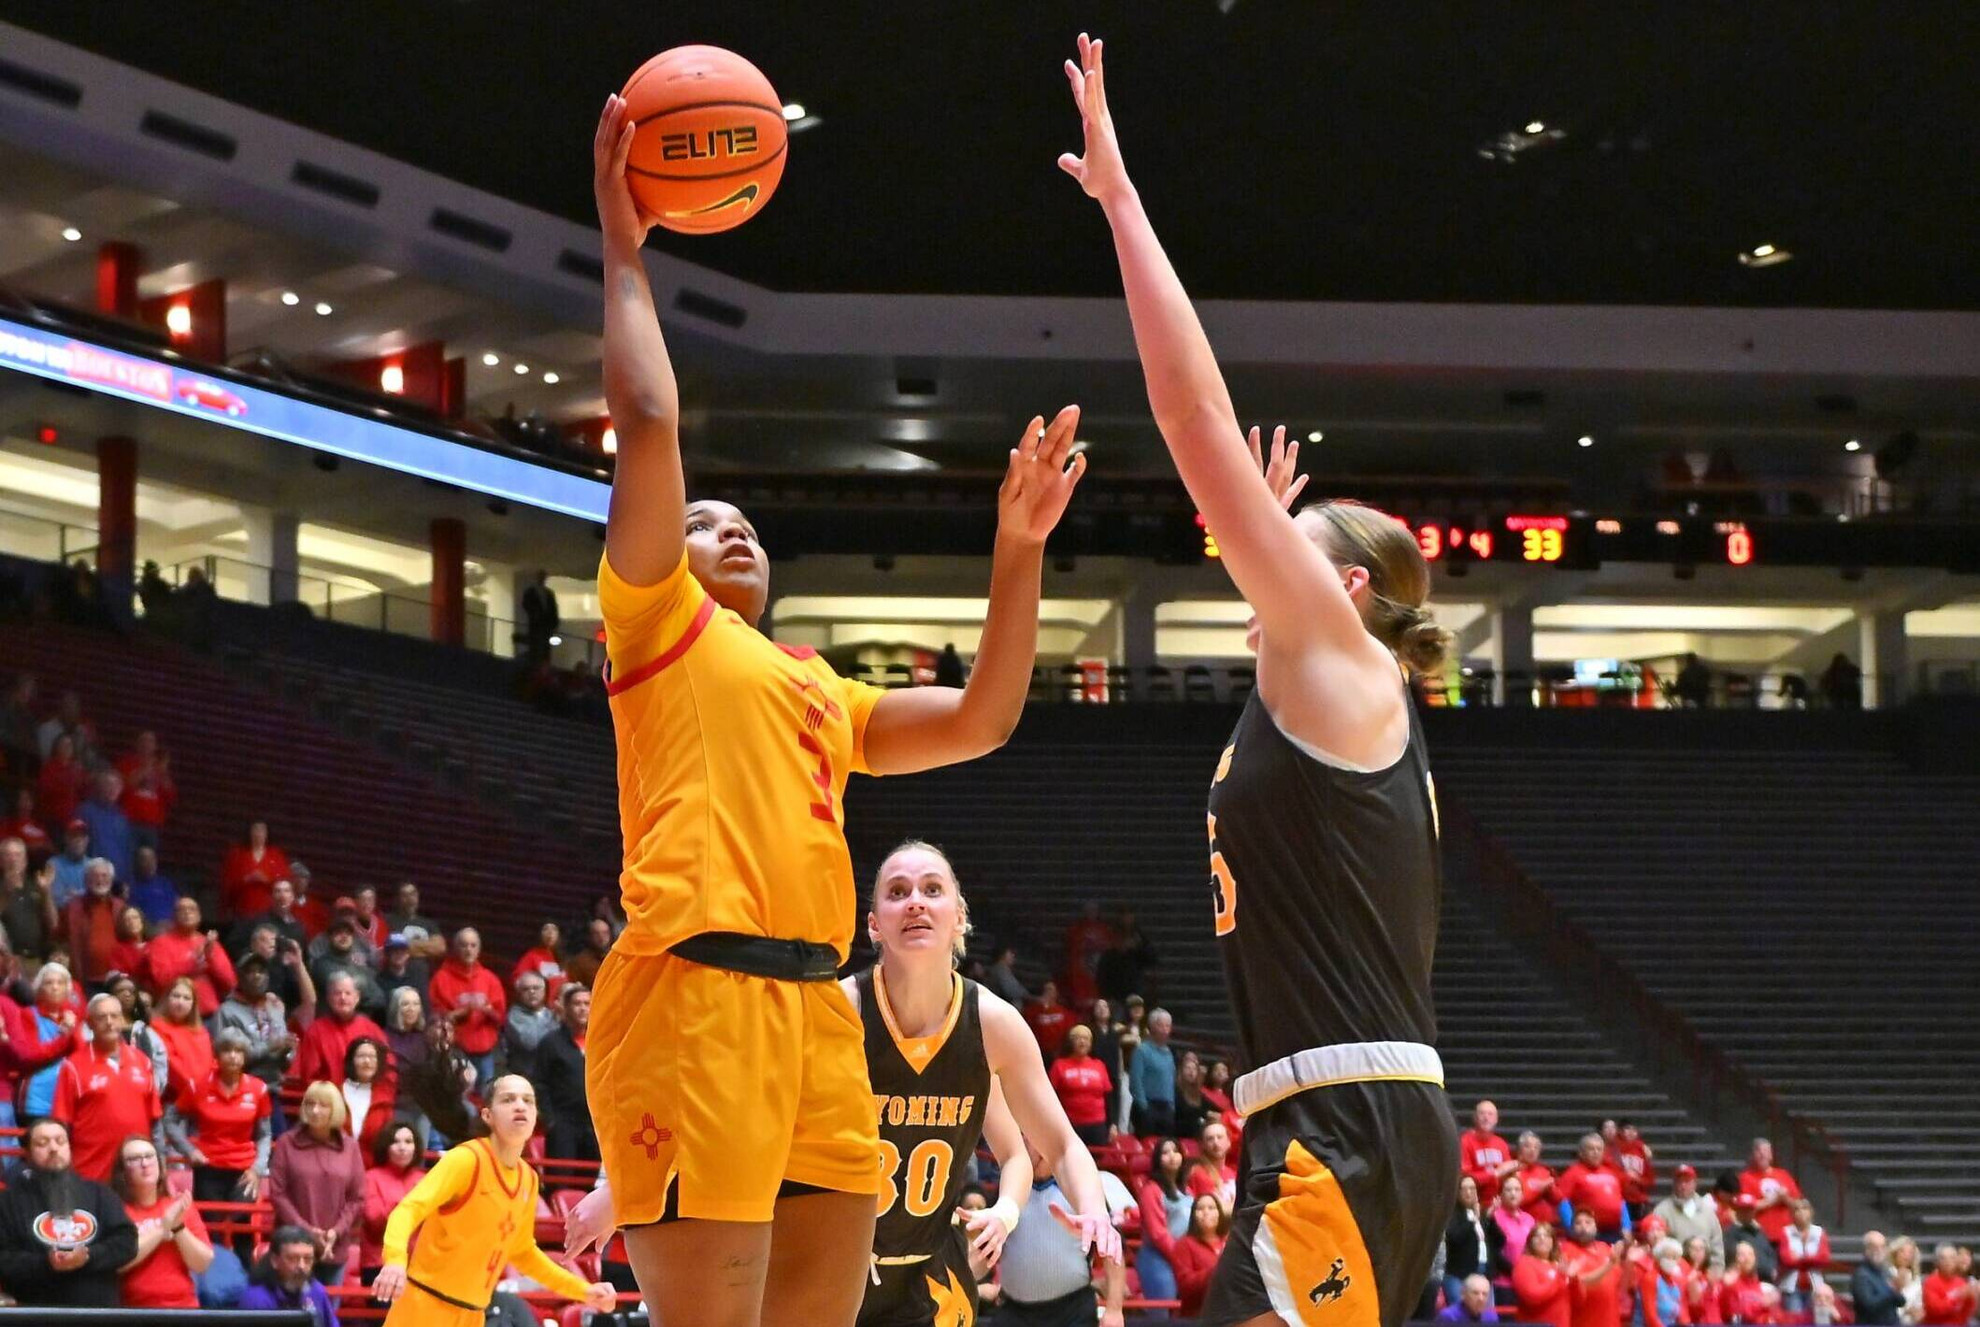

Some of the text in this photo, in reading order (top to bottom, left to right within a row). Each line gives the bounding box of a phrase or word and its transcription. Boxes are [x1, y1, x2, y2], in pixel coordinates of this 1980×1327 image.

[661, 126, 758, 161] ELITE
[1469, 531, 1490, 559] 4
[1523, 528, 1562, 560] 33
[1728, 532, 1750, 564] 0
[798, 731, 836, 822] 3
